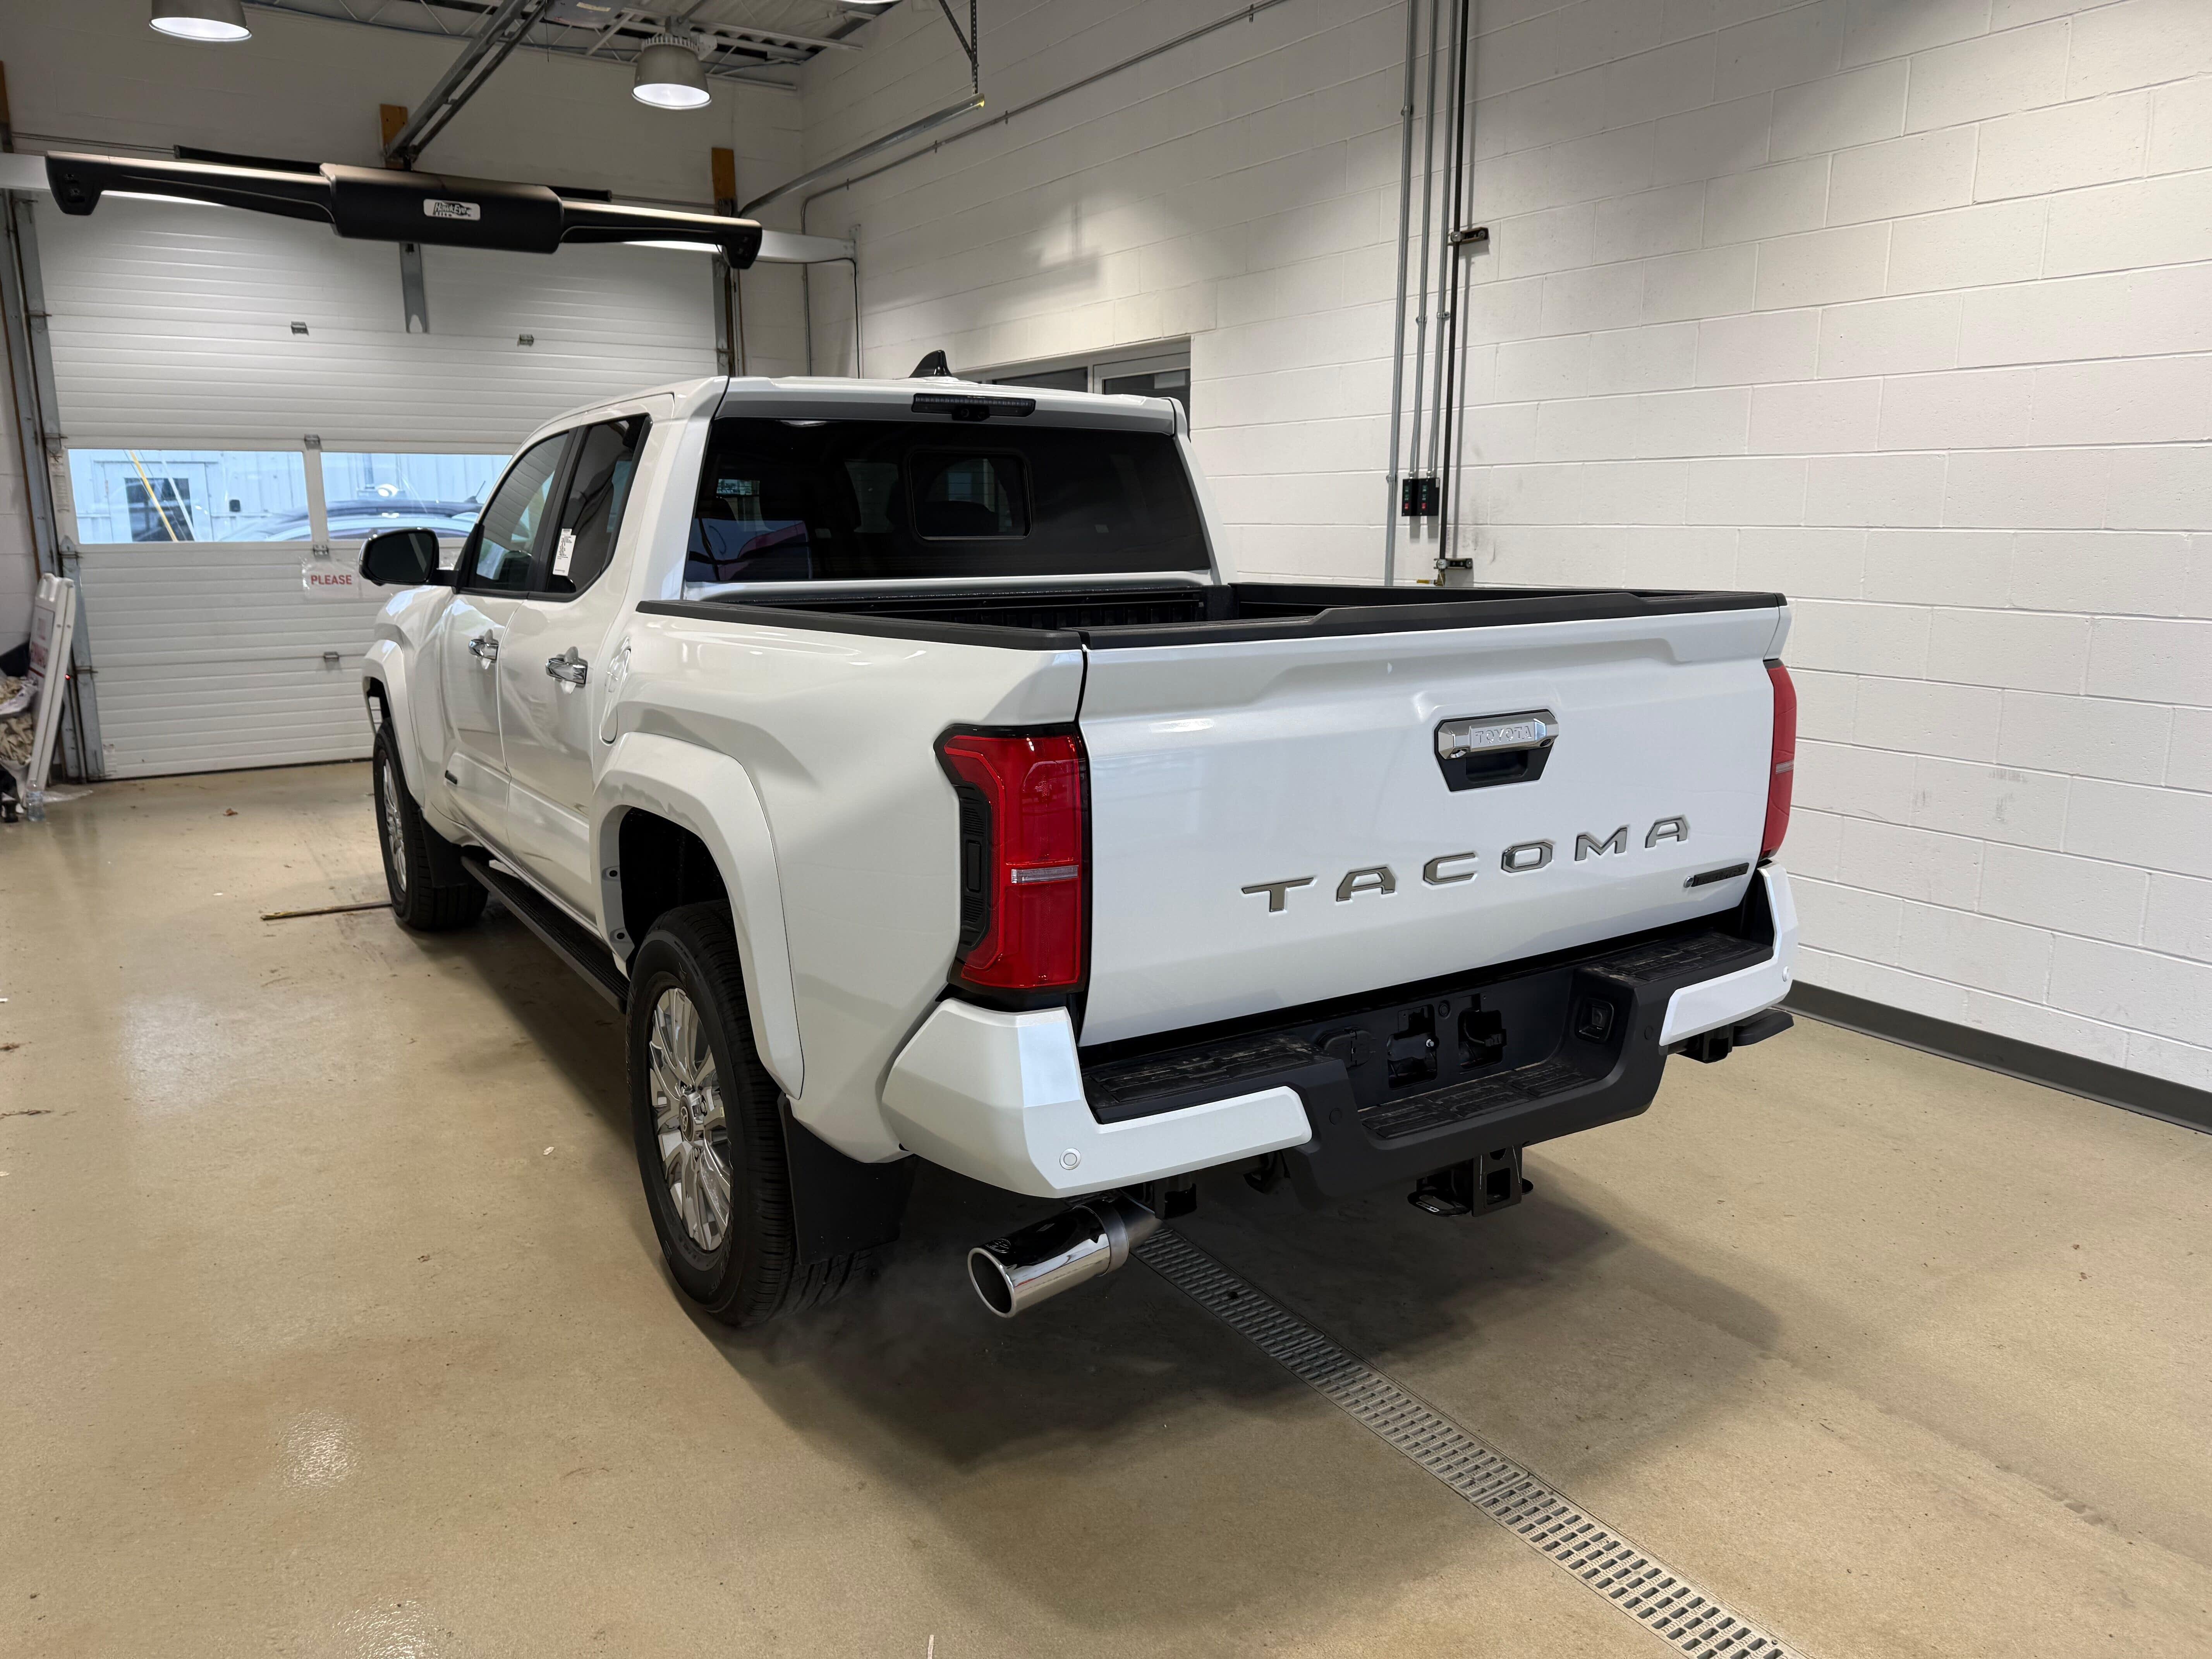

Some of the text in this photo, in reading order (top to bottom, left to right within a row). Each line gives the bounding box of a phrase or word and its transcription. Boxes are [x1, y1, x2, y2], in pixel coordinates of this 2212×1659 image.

[311, 575, 352, 585] PLEASE
[1475, 725, 1532, 744] TOYOTA
[1241, 815, 1691, 913] TACOMA
